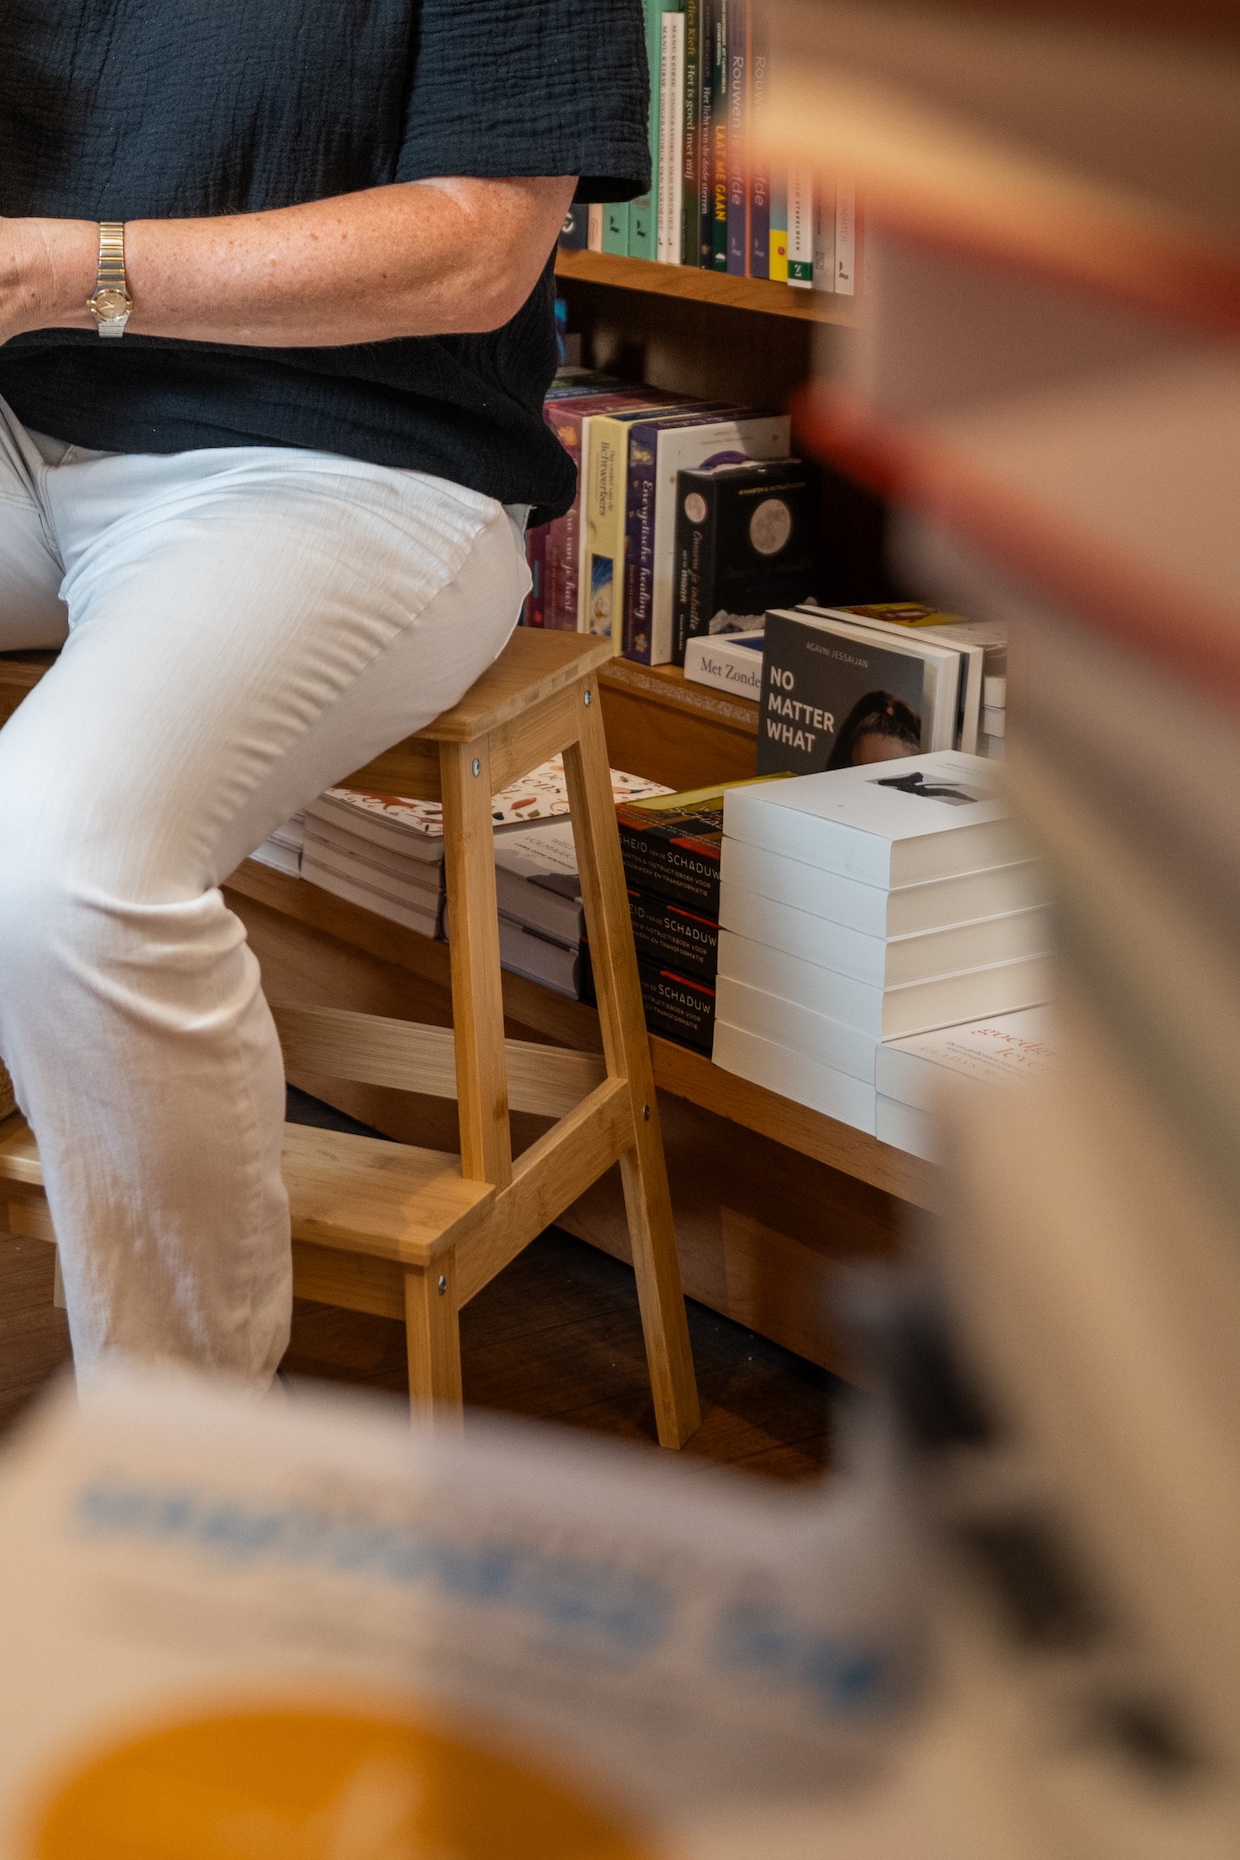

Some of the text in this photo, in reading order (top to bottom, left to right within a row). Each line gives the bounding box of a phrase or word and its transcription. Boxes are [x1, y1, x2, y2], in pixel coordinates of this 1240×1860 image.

[731, 56, 745, 128] Rouwen
[659, 92, 667, 164] VINGERAFDRUK
[668, 92, 677, 162] VINGERAFDRUK
[683, 65, 696, 180] Het is goed met mij
[701, 86, 711, 214] Het licht van de sterren
[715, 125, 726, 221] LAAT ME GAAN
[598, 441, 610, 517] lichtwerkers
[634, 480, 653, 620] Energetische healing
[562, 534, 574, 612] van je hart
[679, 569, 689, 603] maan
[805, 641, 831, 656] AGAVNI
[701, 656, 762, 688] Met Zonde
[770, 665, 795, 691] NO
[768, 693, 835, 734] MATTER
[766, 718, 816, 752] WHAT
[667, 851, 722, 880] SCHADUW
[662, 876, 708, 897] TRANSFORMATIE
[691, 877, 711, 889] VOOR
[664, 917, 717, 947] SCHADUW
[659, 942, 705, 963] TRANSFORMATIE
[691, 944, 708, 954] VOOR
[658, 984, 711, 1015] SCHADUW
[686, 1010, 701, 1022] VOOR
[653, 1005, 699, 1030] TRANSFORMATIE
